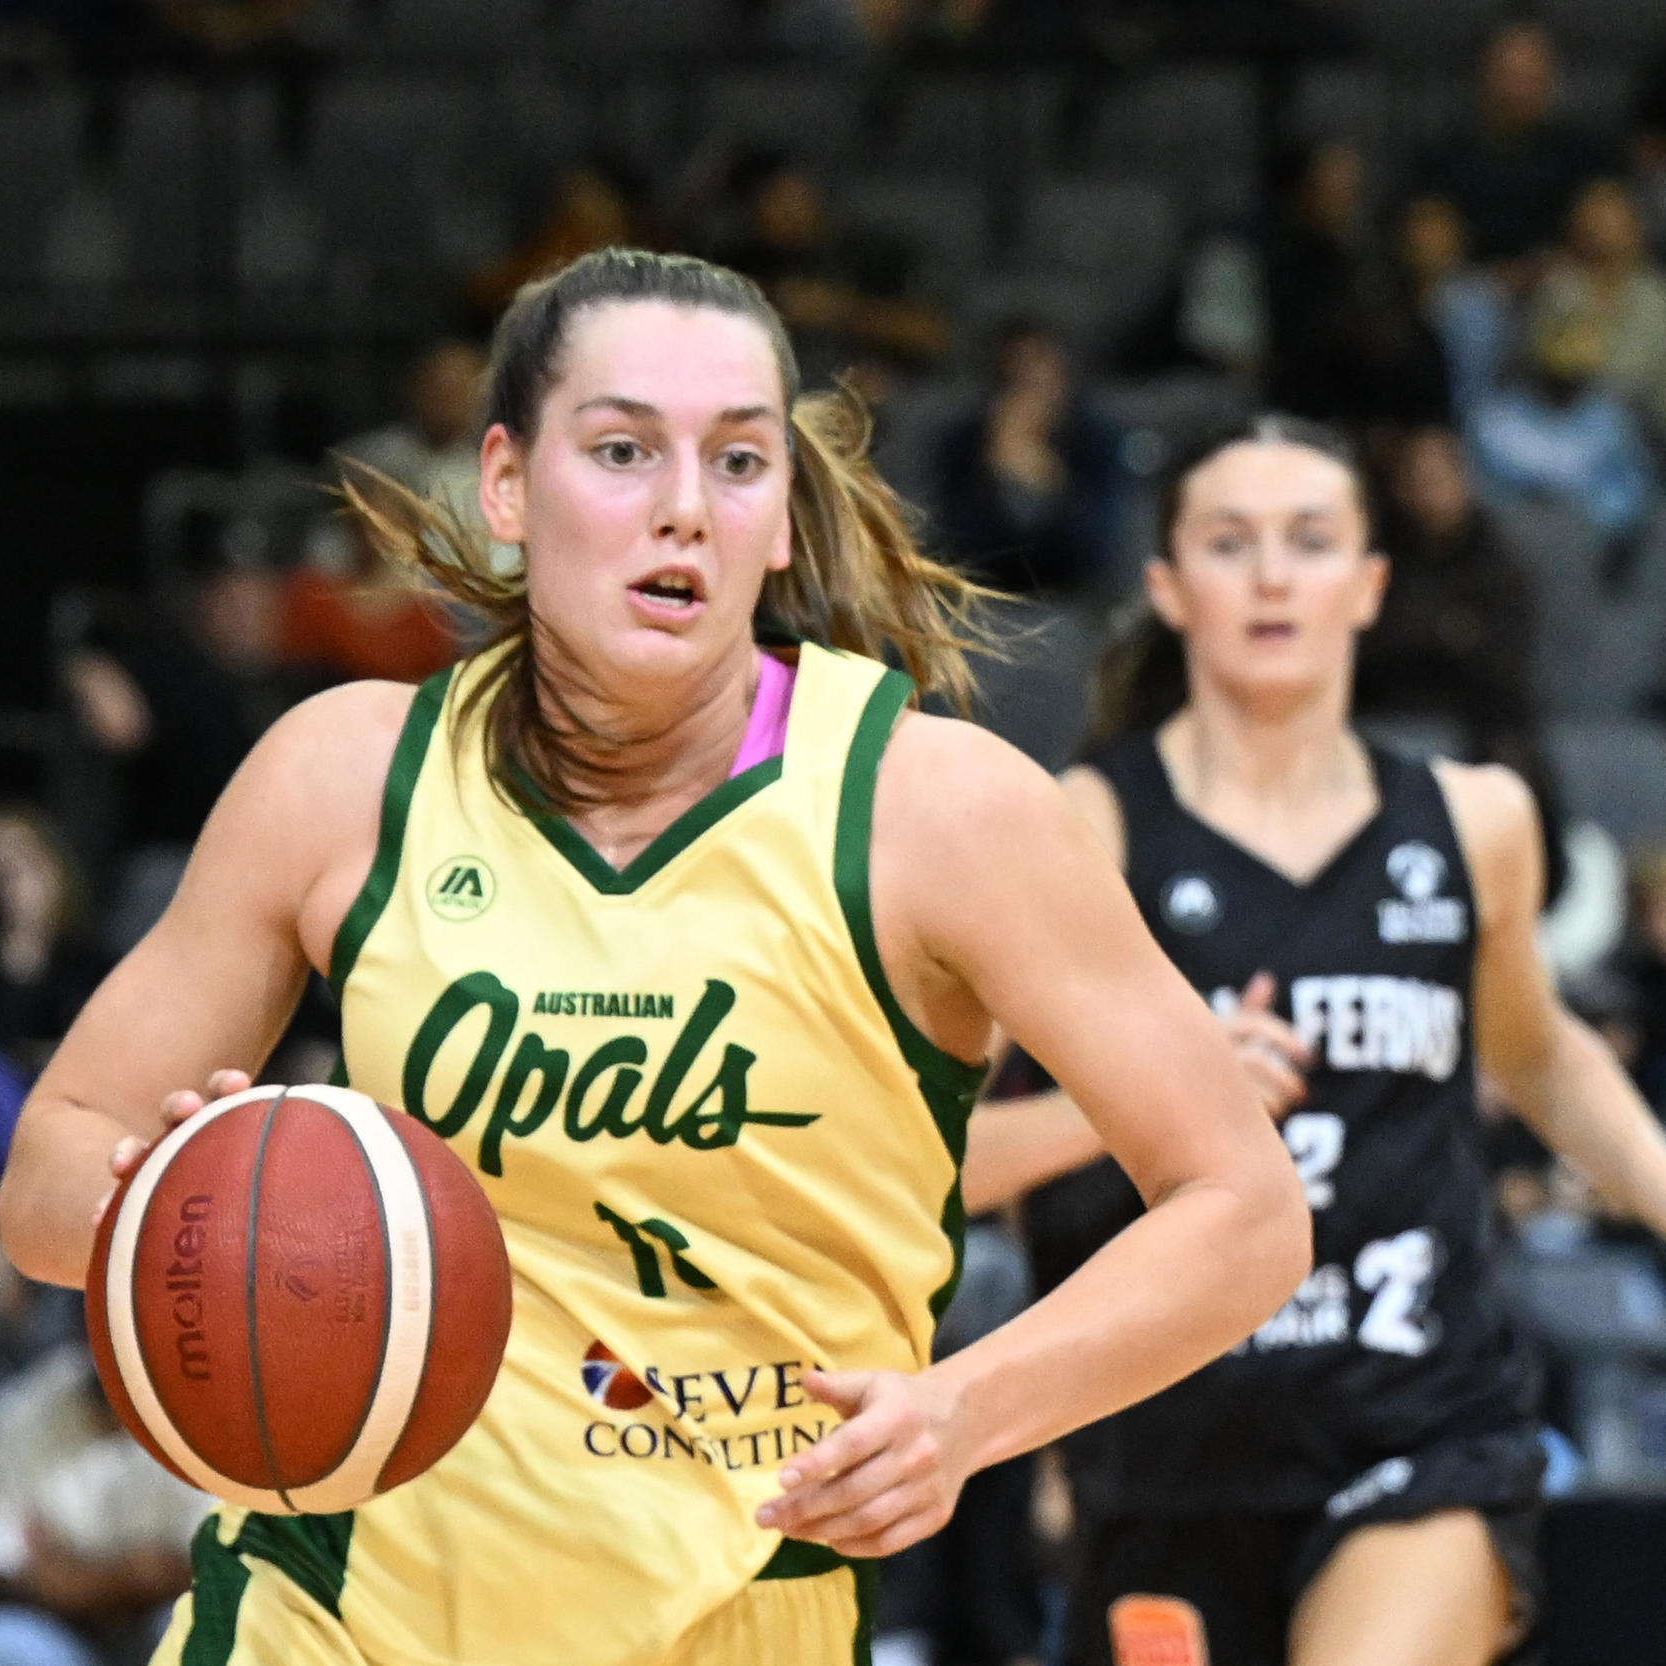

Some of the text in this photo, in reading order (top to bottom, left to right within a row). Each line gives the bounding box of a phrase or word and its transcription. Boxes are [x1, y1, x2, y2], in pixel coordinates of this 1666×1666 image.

[402, 970, 823, 1178] Opals
[533, 991, 674, 1018] AUSTRALIAN
[166, 1194, 213, 1381] molten
